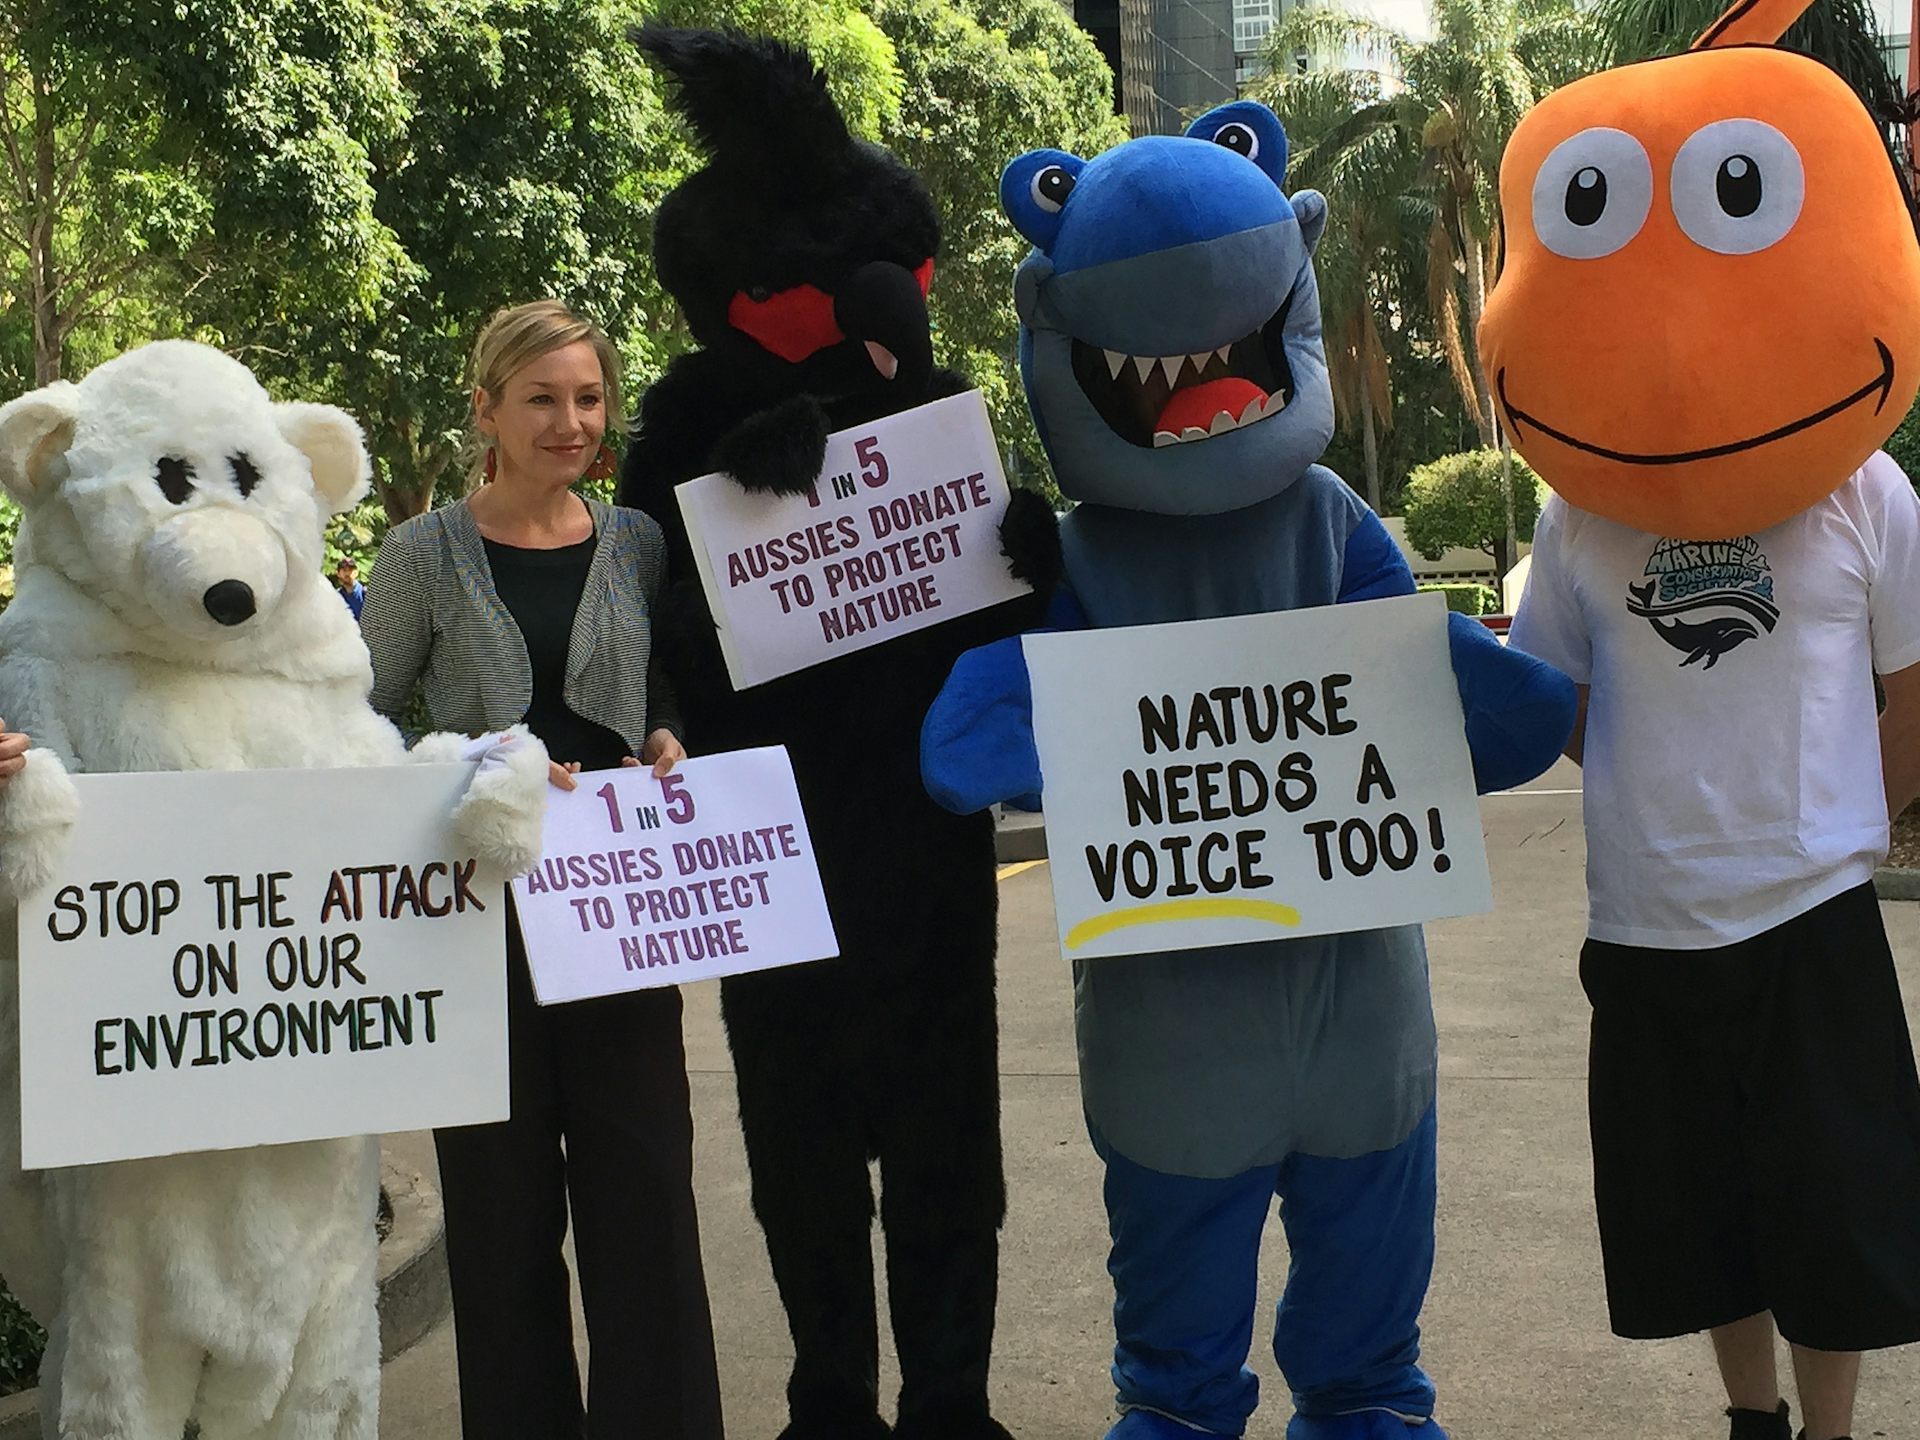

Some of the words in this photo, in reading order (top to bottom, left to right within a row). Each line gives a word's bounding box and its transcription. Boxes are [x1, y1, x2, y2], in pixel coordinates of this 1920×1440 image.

[832, 472, 857, 500] IN
[854, 436, 889, 488] 5
[728, 516, 859, 588] AUSSIES
[868, 472, 991, 539] DONATE
[1645, 545, 1744, 575] MARINE
[770, 576, 815, 614] TO
[823, 524, 962, 598] PROTECT
[1659, 578, 1744, 601] SOCIETY
[1660, 565, 1761, 586] CONSERVATION
[818, 575, 942, 643] NATURE
[1138, 673, 1358, 754] NATURE
[596, 782, 625, 833] 1
[636, 806, 661, 830] IN
[660, 773, 696, 825] 5
[1122, 752, 1317, 827] NEEDS
[1356, 743, 1396, 804] A
[527, 847, 663, 895] AUSSIES
[672, 823, 802, 876] DONATE
[1085, 829, 1274, 902] VOICE
[1303, 807, 1452, 881] TOO!
[47, 878, 181, 942] STOP
[204, 871, 295, 931] THE
[320, 858, 486, 923] ATTACK
[570, 896, 616, 932] TO
[624, 871, 771, 926] PROTECT
[173, 940, 238, 998] ON
[266, 932, 367, 991] OUR
[618, 919, 750, 971] NATURE
[94, 989, 445, 1076] ENVIRONMENT
